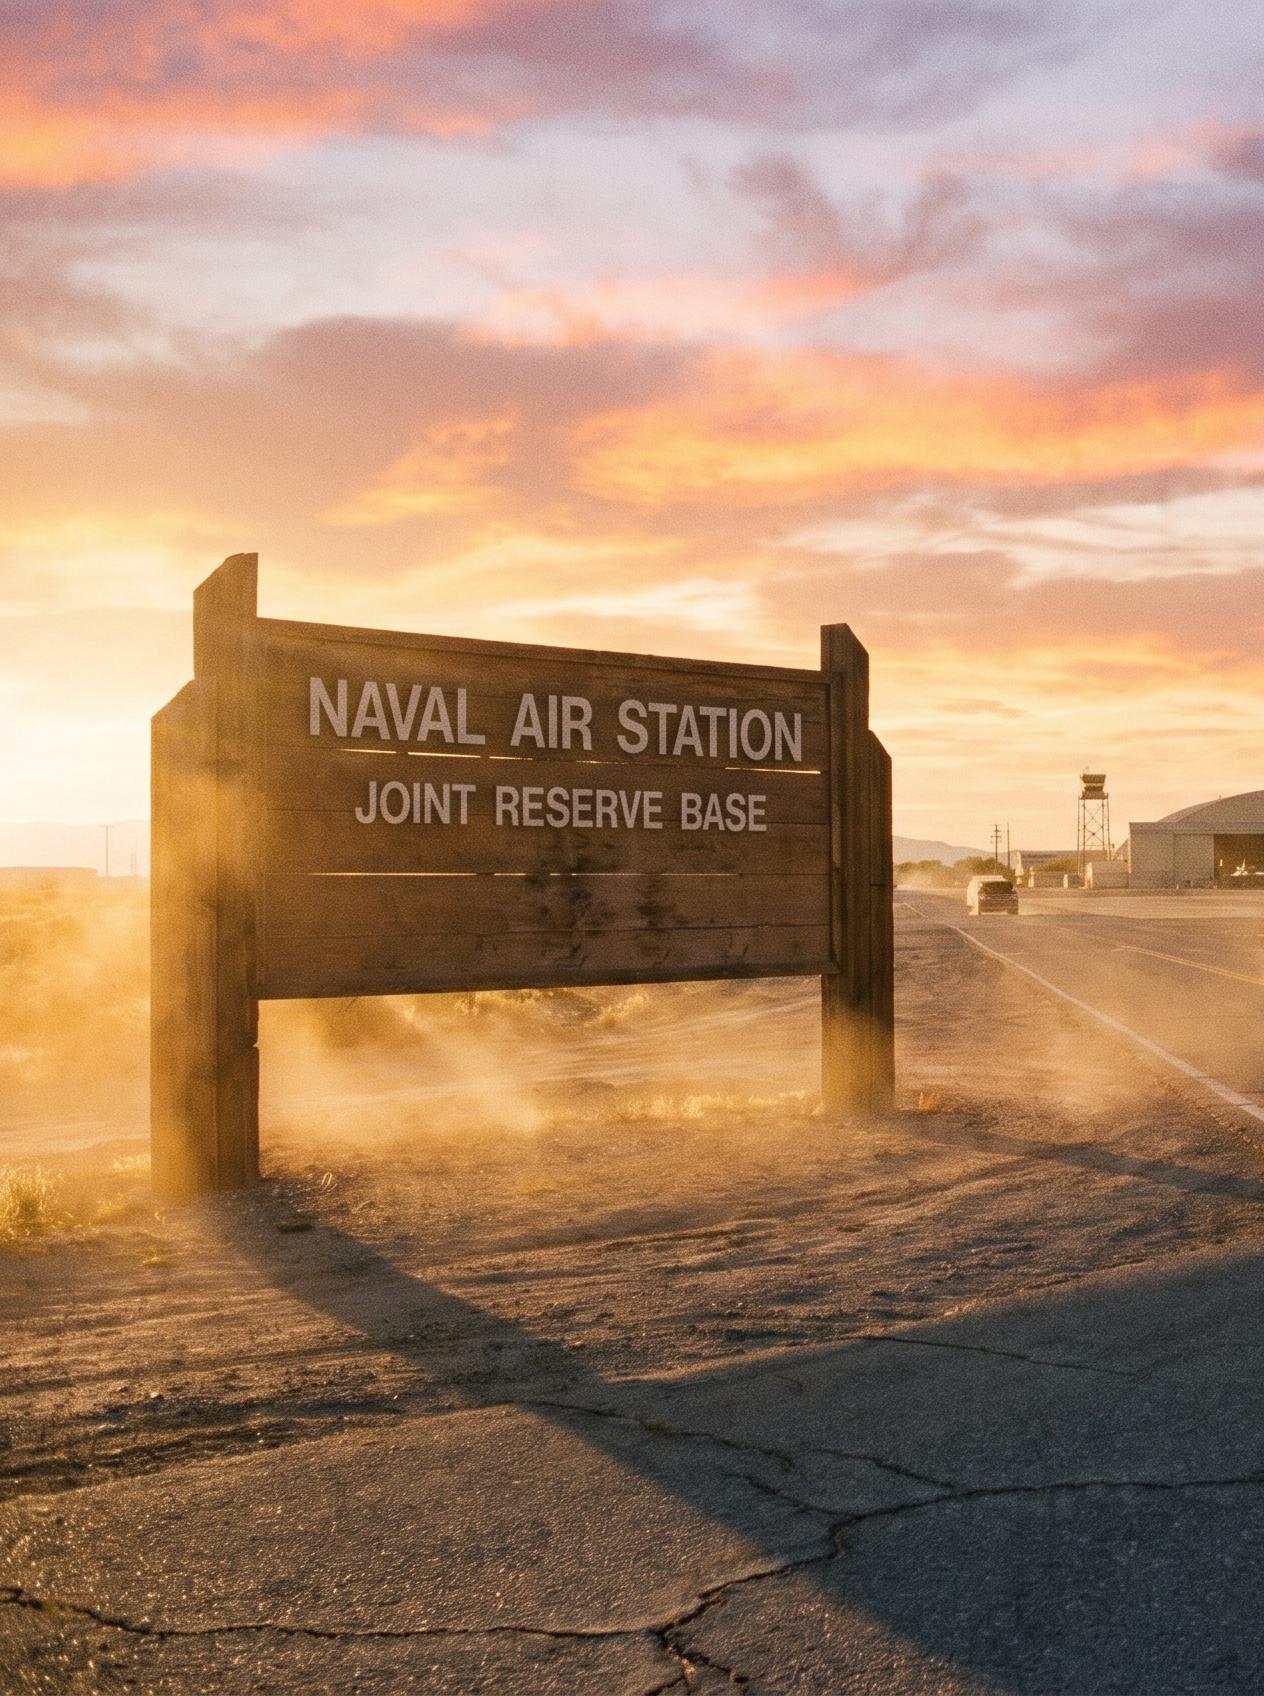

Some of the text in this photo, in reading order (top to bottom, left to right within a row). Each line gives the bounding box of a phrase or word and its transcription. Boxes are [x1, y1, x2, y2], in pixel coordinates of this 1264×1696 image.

[309, 677, 802, 762] NAVAL AIR STATION
[355, 781, 767, 832] JOINT RESERVE BASE
